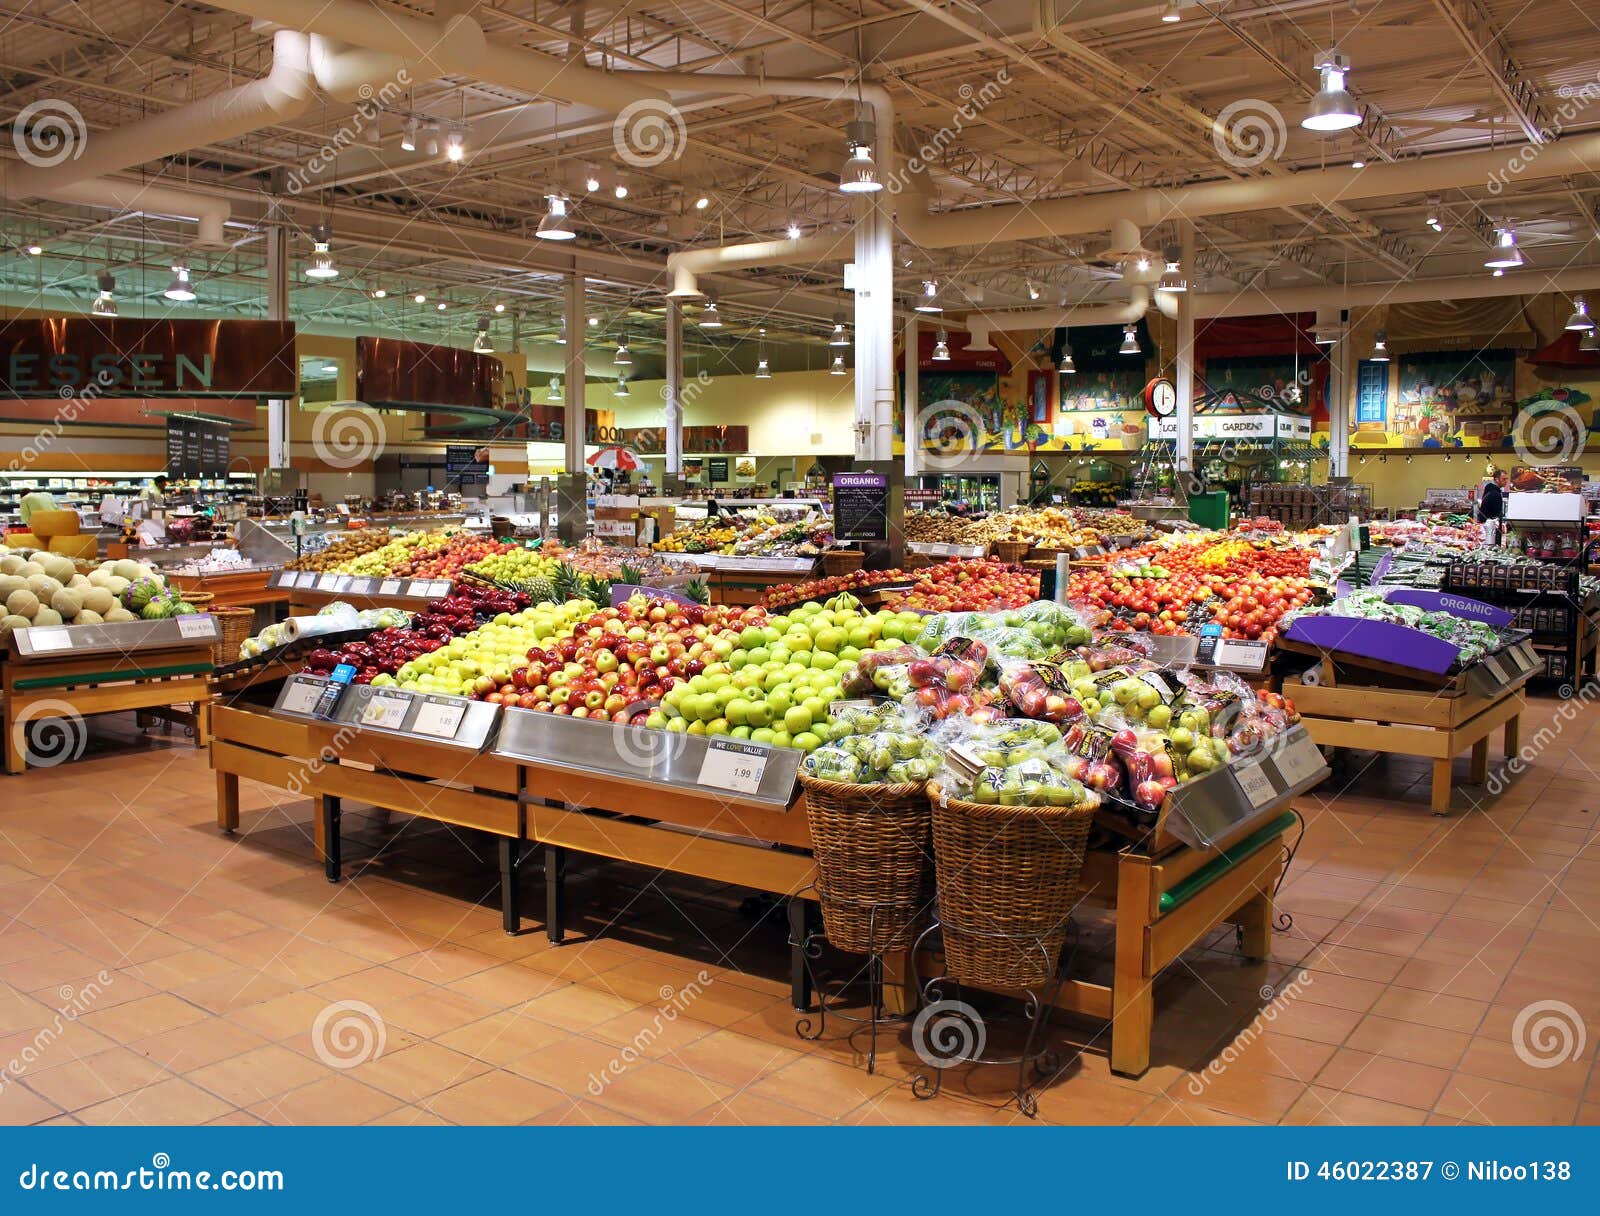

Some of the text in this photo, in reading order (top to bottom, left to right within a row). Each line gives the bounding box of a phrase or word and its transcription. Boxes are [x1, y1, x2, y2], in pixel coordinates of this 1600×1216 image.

[1222, 422, 1263, 431] GARDENS
[840, 476, 880, 485] ORGANIC
[1440, 597, 1493, 616] ORGANIC
[716, 741, 726, 749] WE
[743, 746, 763, 755] VALUE
[734, 768, 751, 778] 1.99
